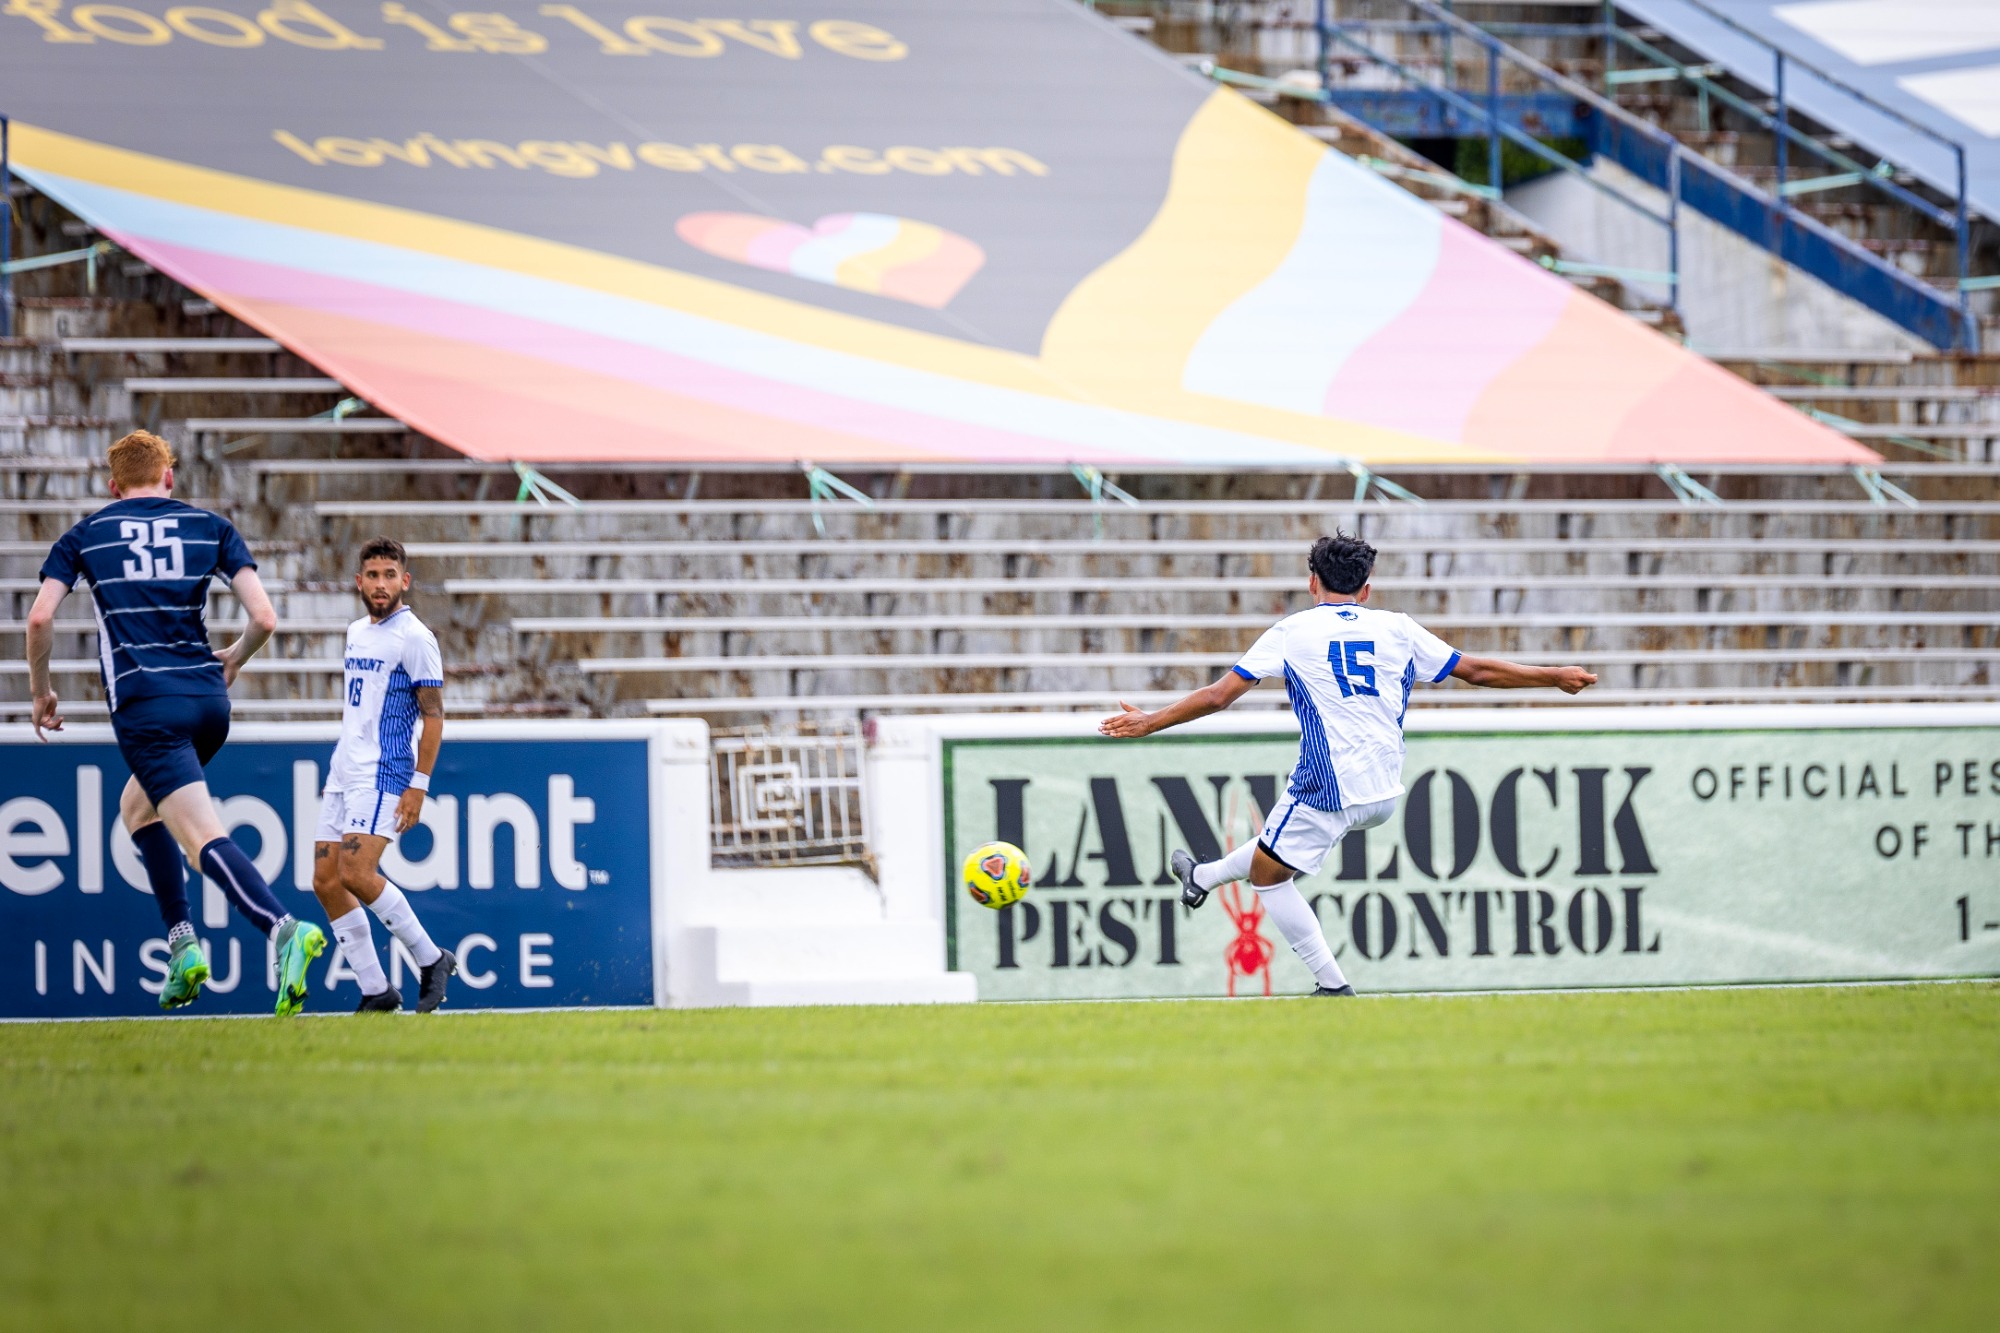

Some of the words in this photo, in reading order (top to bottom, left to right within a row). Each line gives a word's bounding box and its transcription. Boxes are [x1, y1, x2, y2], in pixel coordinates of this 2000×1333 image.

[3, 0, 386, 50] food
[381, 1, 549, 54] is
[539, 2, 909, 62] love
[272, 128, 1052, 179] lovingvera.com
[119, 518, 186, 581] 35
[347, 676, 364, 707] 18
[1326, 640, 1380, 698] 15
[1691, 762, 1909, 801] OFFICIAL
[987, 766, 1660, 888] LANLOCK
[1875, 821, 1931, 859] OF
[995, 898, 1191, 969] PEST
[1308, 885, 1662, 961] CONTROL
[34, 931, 555, 996] INSUANCE
